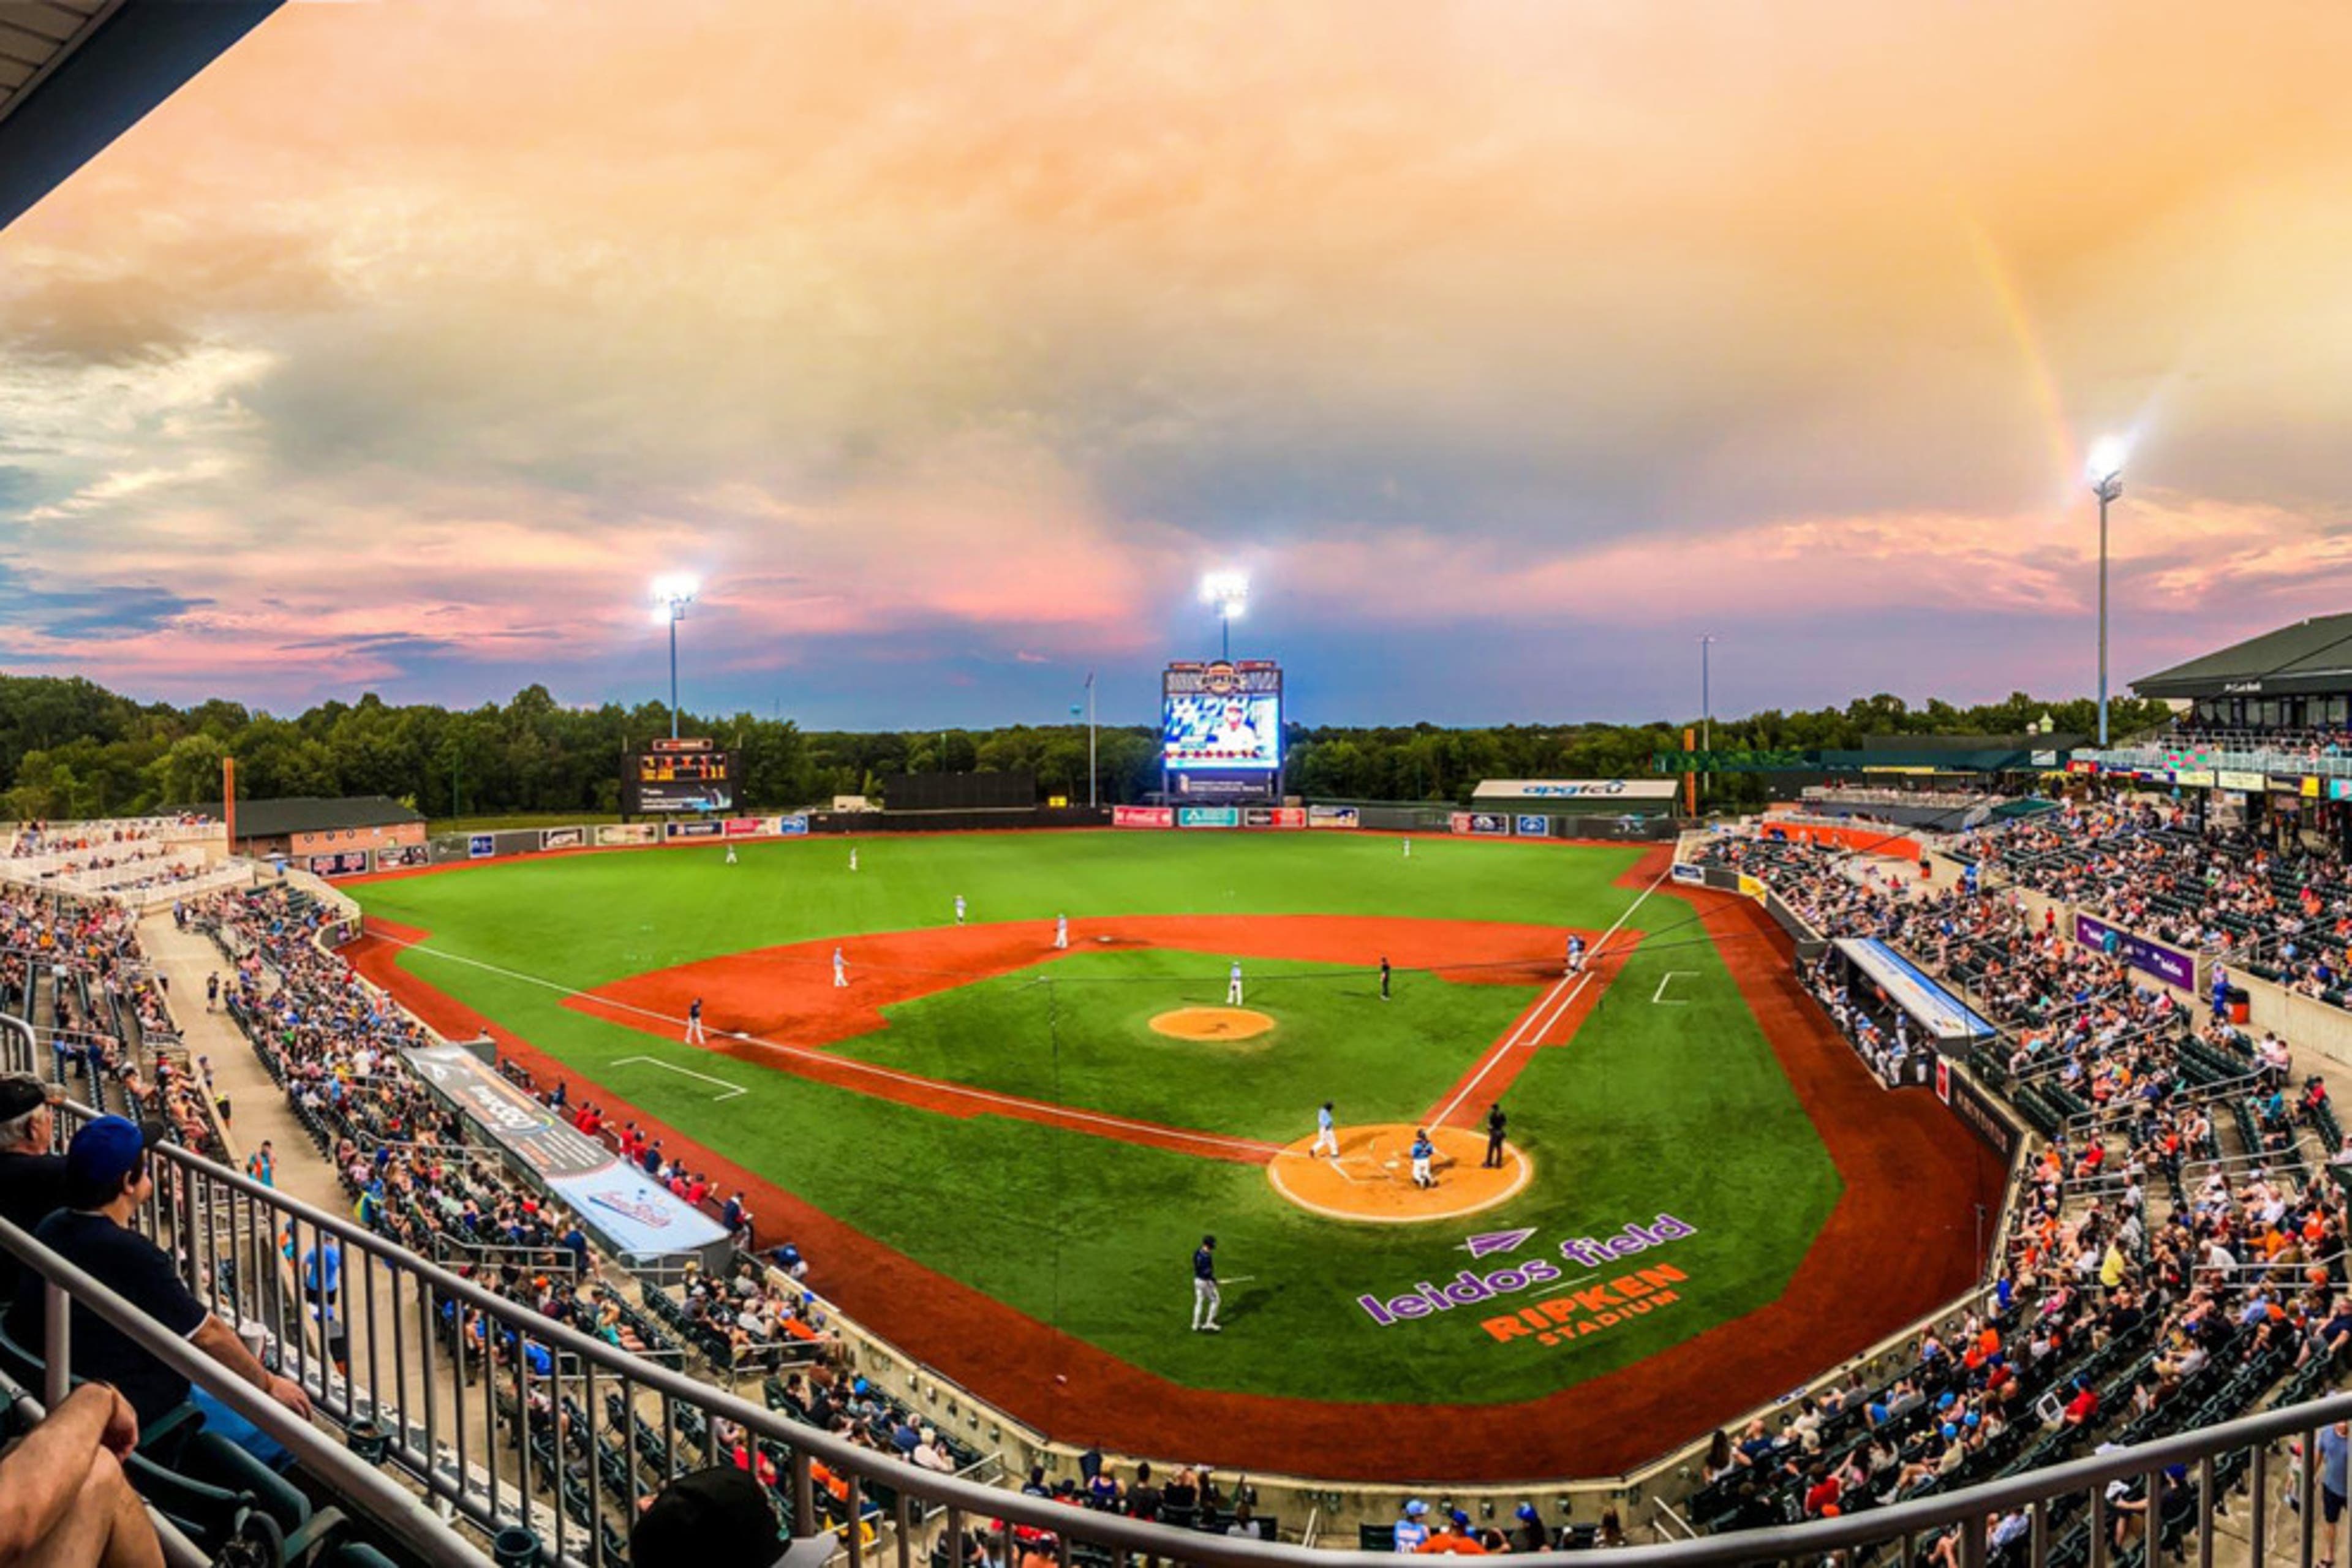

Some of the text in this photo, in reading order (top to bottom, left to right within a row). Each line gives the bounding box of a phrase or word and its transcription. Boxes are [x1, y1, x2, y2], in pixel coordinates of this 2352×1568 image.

[1357, 1213, 1698, 1325] leidos field
[1480, 1263, 1689, 1342] RIPKEN
[1537, 1290, 1680, 1346] STADIUM
